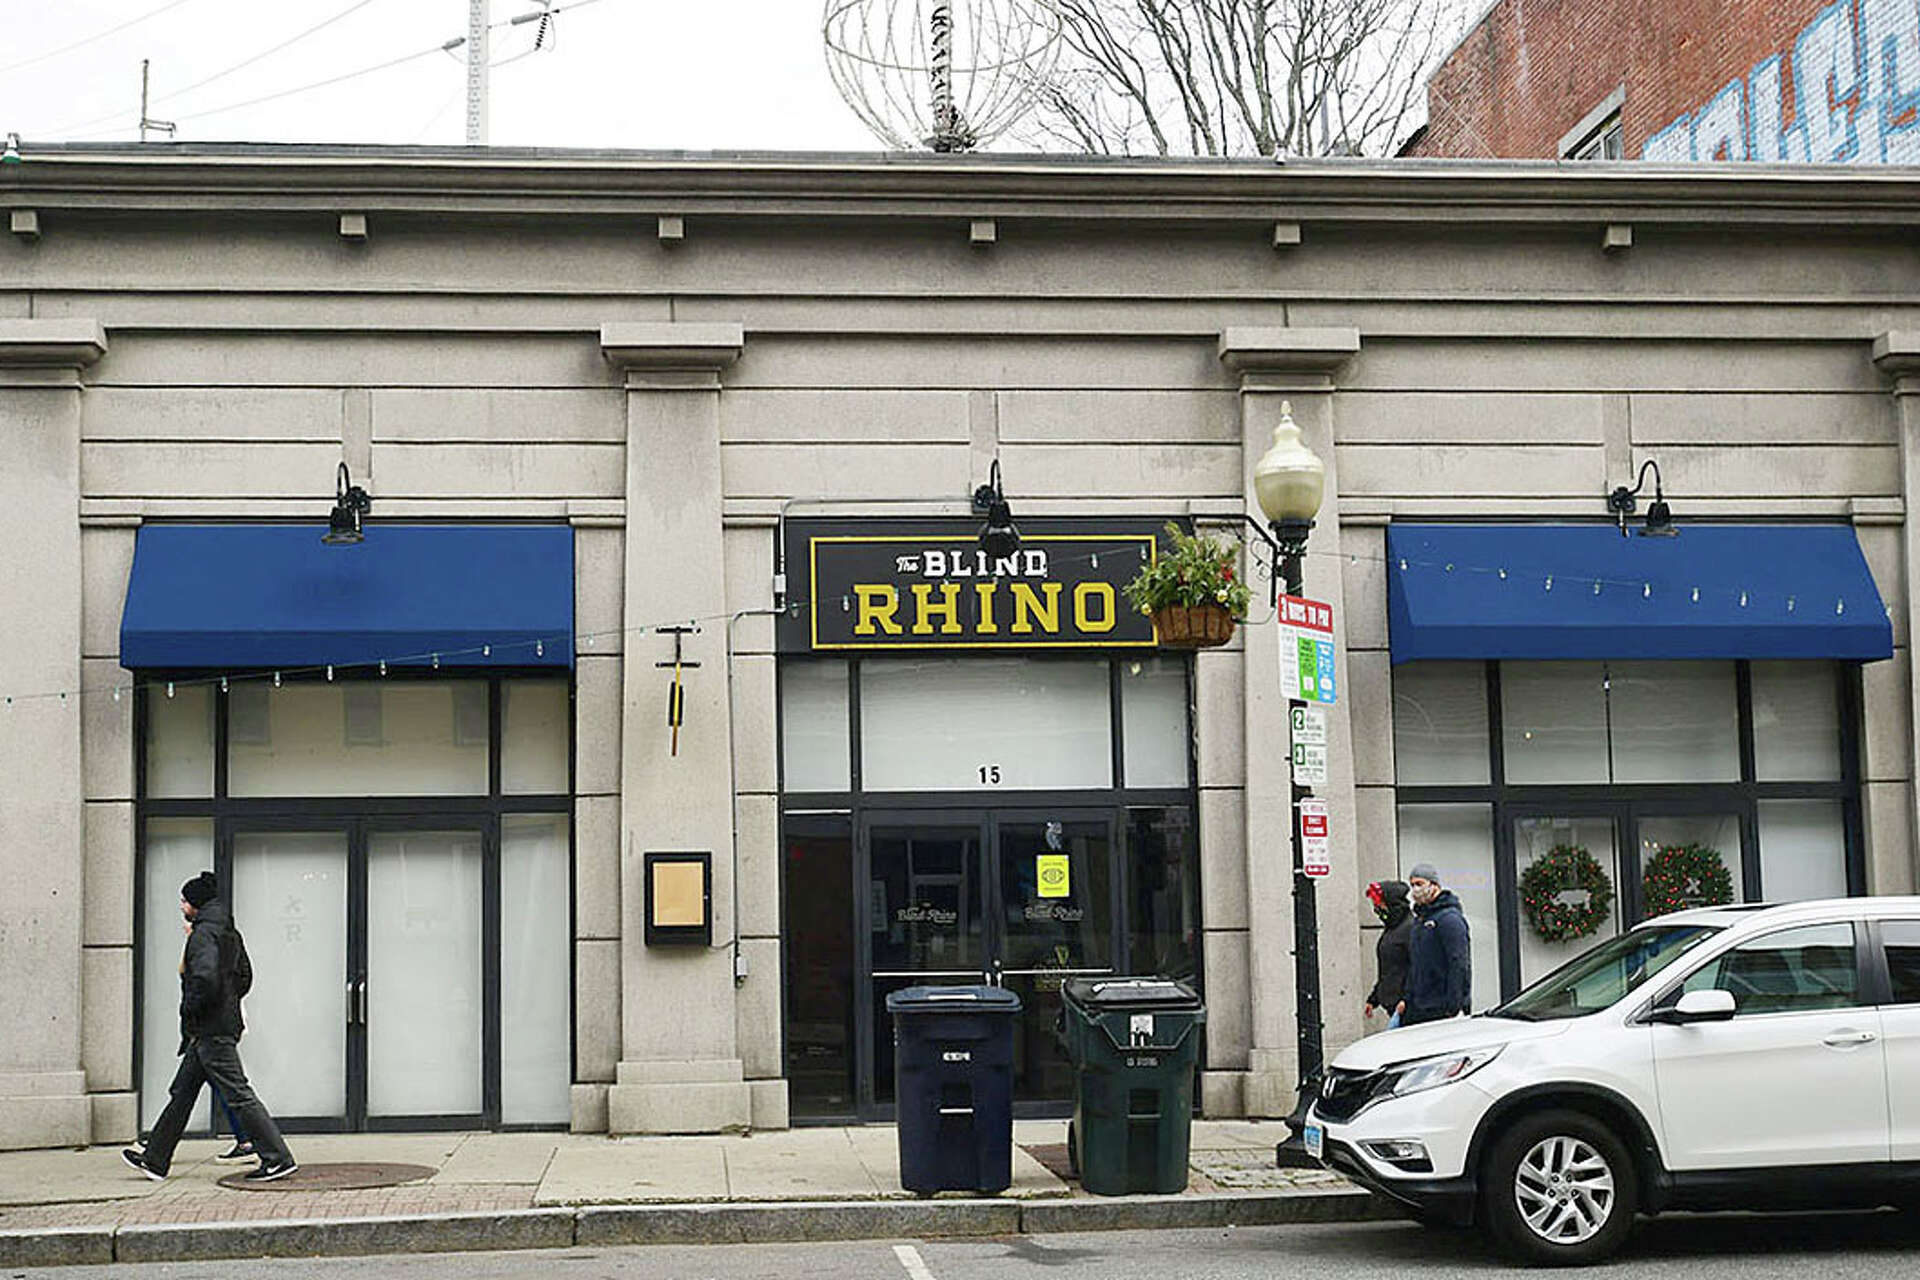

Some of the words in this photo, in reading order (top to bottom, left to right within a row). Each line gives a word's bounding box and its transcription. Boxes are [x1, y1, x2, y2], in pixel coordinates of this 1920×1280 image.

[896, 555, 918, 573] The
[923, 551, 1048, 576] BLIND
[853, 582, 1116, 634] RHINO
[978, 765, 1001, 784] 15
